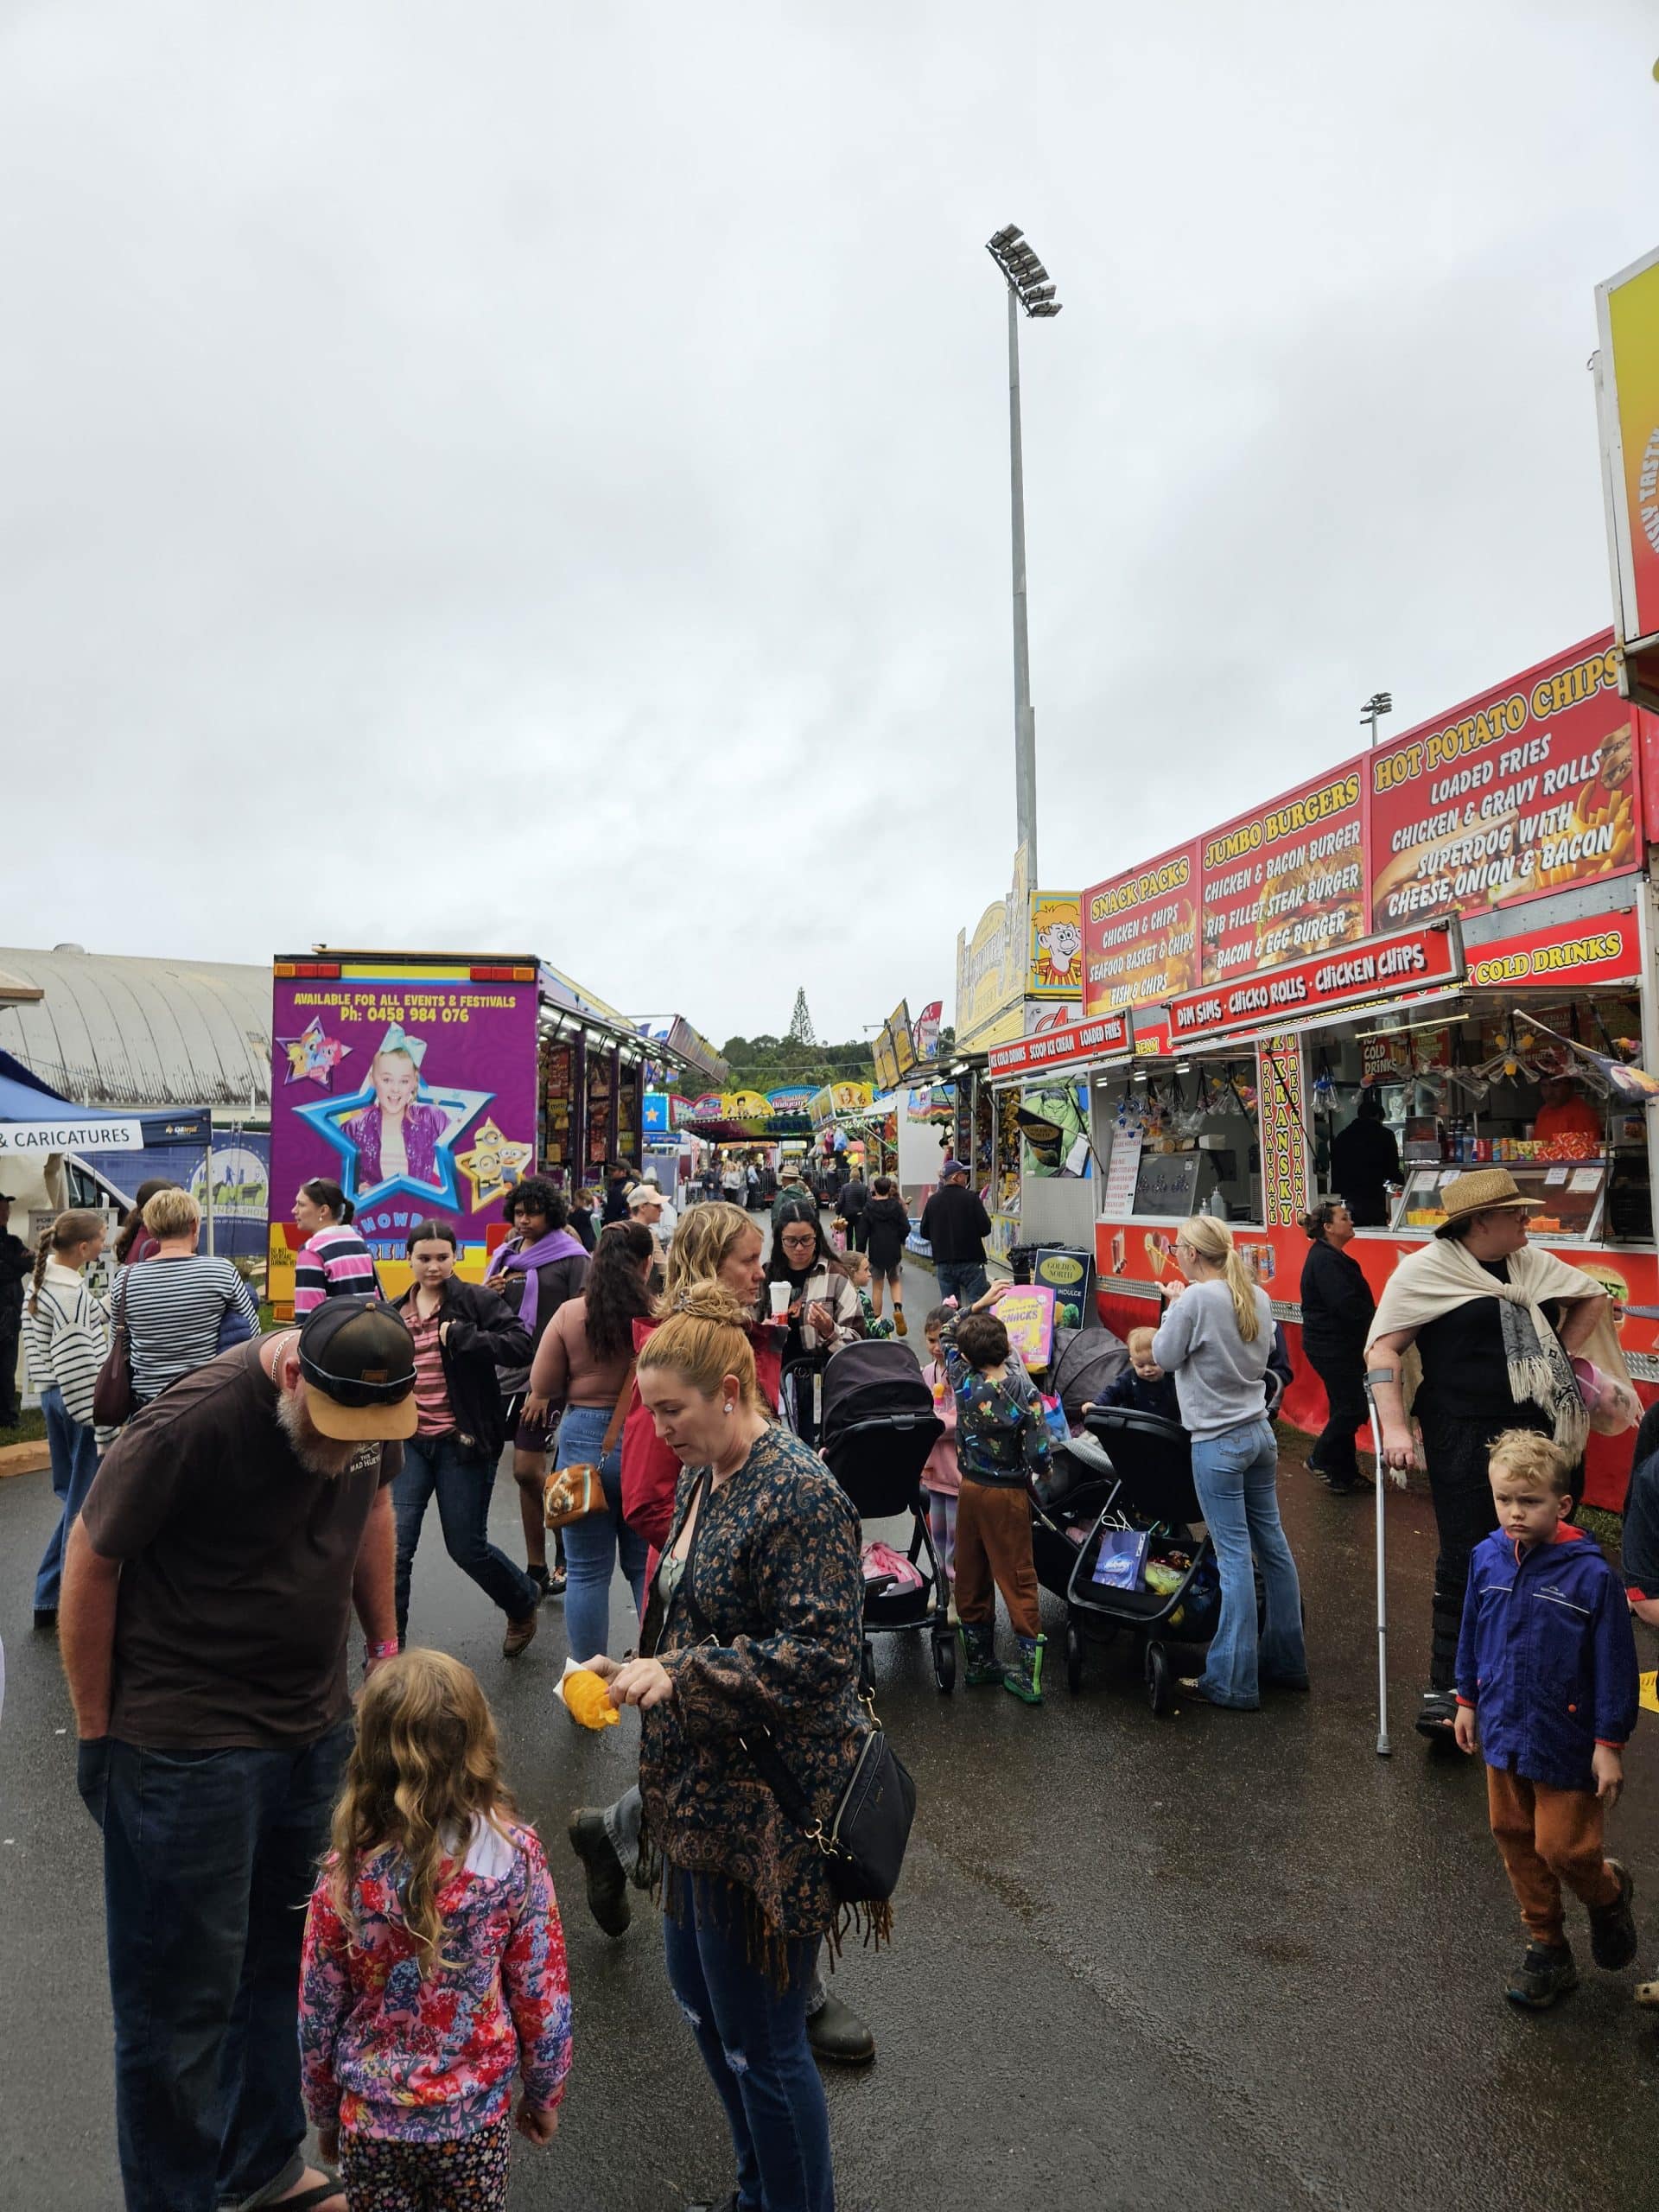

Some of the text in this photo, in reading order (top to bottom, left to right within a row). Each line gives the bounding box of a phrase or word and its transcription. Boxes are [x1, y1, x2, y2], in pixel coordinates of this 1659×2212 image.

[1376, 647, 1619, 792] HOT POTATO CHIPS
[1431, 734, 1551, 804] LOADED FRIES
[1205, 773, 1359, 869] JUMBO BURGERS
[1391, 749, 1603, 852] CHICKEN & GRAVY ROLLS
[1205, 822, 1360, 902] CHICKEN & BACON BURGER
[1416, 801, 1573, 879] SUPERDOG WITH
[1520, 850, 1535, 877] &
[1541, 823, 1614, 872] BACON
[1091, 856, 1190, 921] SNACK PACKS
[1207, 865, 1359, 938] RIB FILLET STEAK BURGER
[1103, 904, 1179, 949] CHICKEN & CHIPS
[1217, 911, 1345, 969] BACON & EGG BURGER
[1089, 931, 1194, 982] SEAFOOD BASKET & CHIPS
[1477, 955, 1529, 983] COLD
[1533, 933, 1621, 973] DRINKS
[294, 994, 516, 1007] AVAILABLE FOR ALL EVENTS & FESTIVALS
[1110, 972, 1167, 1007] FISH & CHIPS
[1271, 977, 1306, 1004] ROLLS
[340, 1007, 469, 1023] Ph: 0458 984 076
[997, 1050, 1009, 1066] COLD
[1009, 1046, 1027, 1064] DRINKS
[1030, 1042, 1046, 1059] SCOOP
[1047, 1039, 1056, 1056] ICE
[1057, 1034, 1074, 1054] CREAM
[1080, 1026, 1103, 1046] LOADED
[1105, 1020, 1122, 1039] FRIES
[1136, 1038, 1160, 1054] REAM
[1364, 1045, 1385, 1059] COLD
[1289, 1057, 1299, 1105] RED
[0, 1128, 129, 1147] & CARICATURES
[1262, 1061, 1277, 1224] PORK SAUSAGE
[1274, 1058, 1291, 1224] KRANSKY
[1047, 1262, 1076, 1271] GOLDEN
[1050, 1270, 1073, 1279] NORTH
[1002, 1311, 1038, 1323] SNACKS
[350, 1461, 363, 1472] MAD
